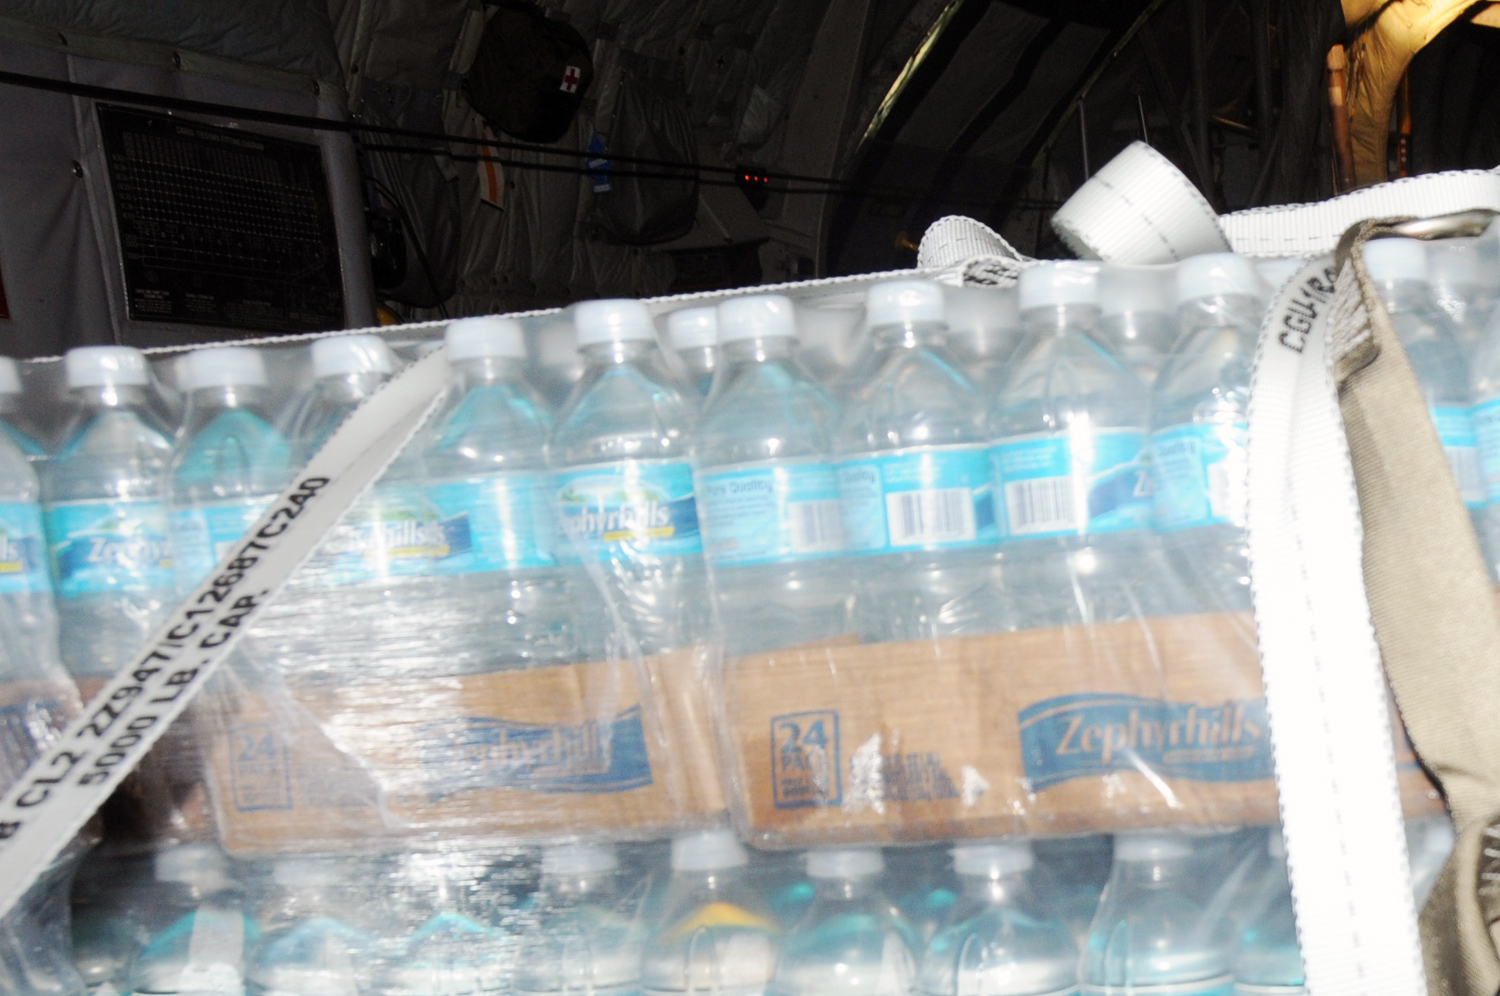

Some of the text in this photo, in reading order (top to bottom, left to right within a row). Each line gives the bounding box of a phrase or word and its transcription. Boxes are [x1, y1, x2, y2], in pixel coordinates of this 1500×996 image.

[78, 589, 270, 787] 5000 LB. CAP.
[779, 719, 830, 755] 24
[1056, 703, 1262, 766] Zephyrhills
[16, 751, 79, 808] CL2
